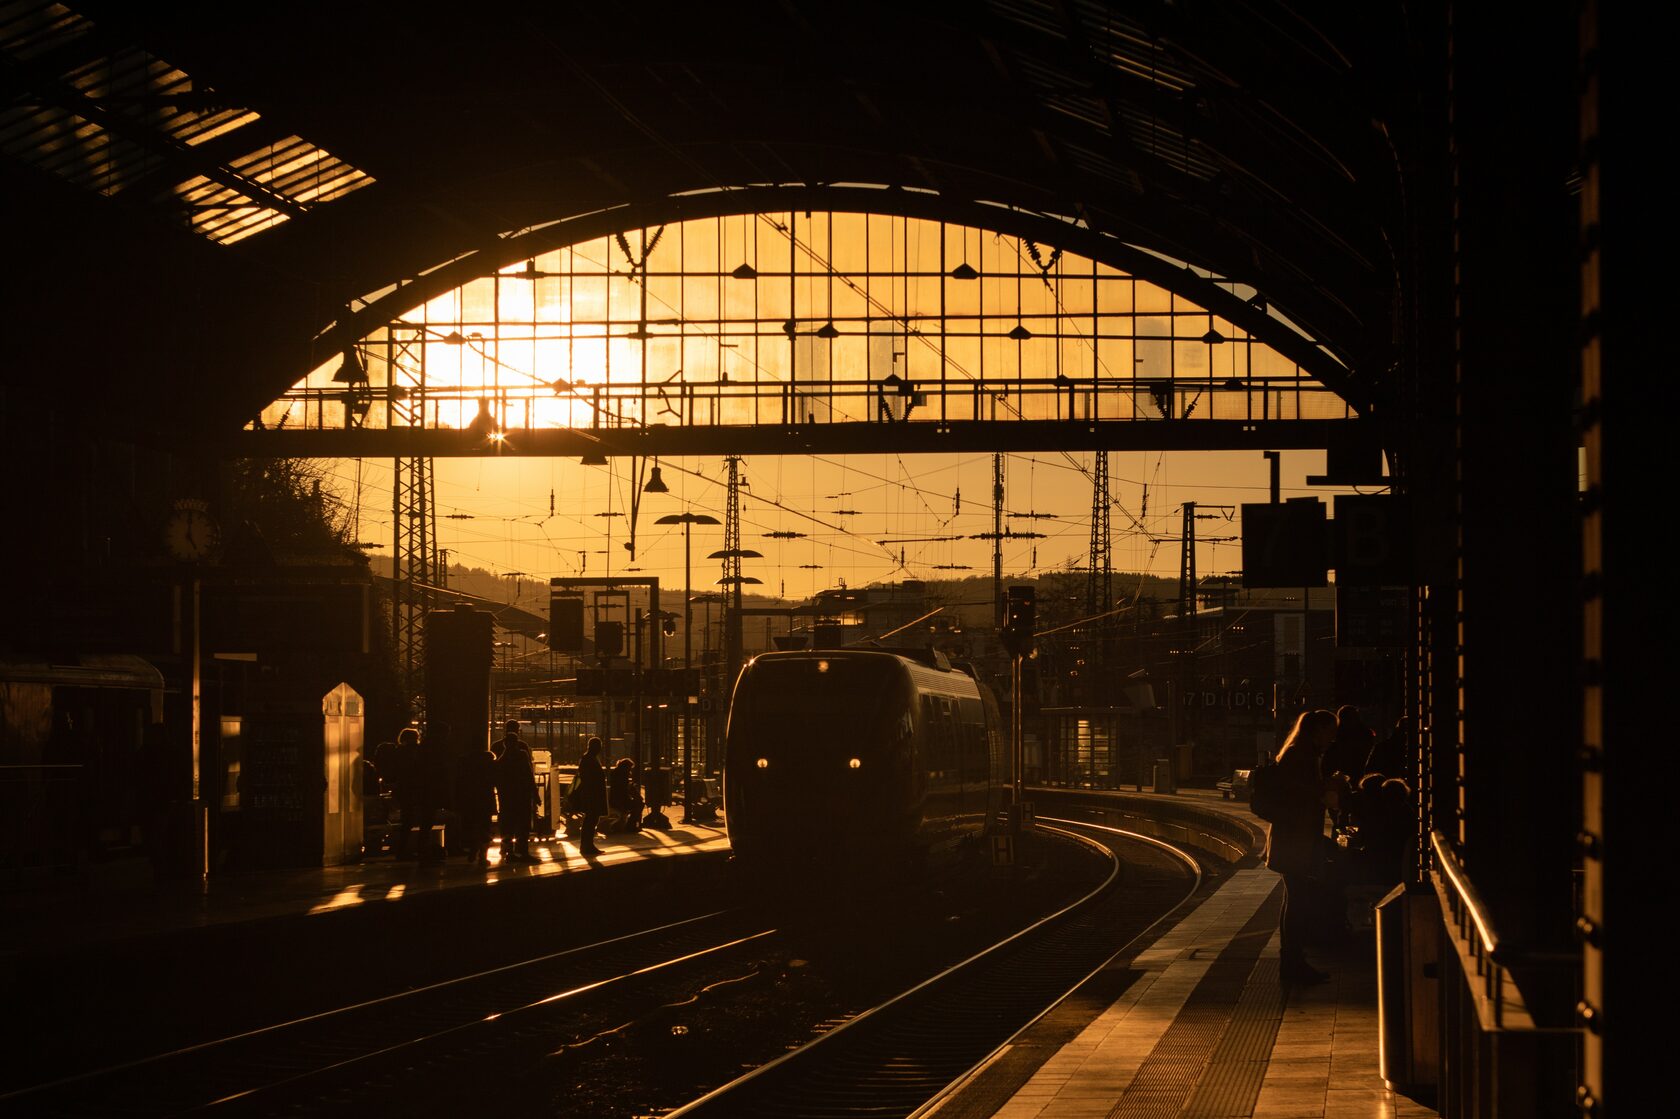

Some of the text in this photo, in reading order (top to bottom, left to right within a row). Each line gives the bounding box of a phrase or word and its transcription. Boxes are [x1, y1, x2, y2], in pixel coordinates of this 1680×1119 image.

[1253, 508, 1288, 568] 7
[1345, 505, 1392, 567] B
[1186, 692, 1216, 706] 7 D
[1235, 692, 1265, 706] D 6
[1022, 803, 1034, 822] H
[994, 837, 1011, 864] H
